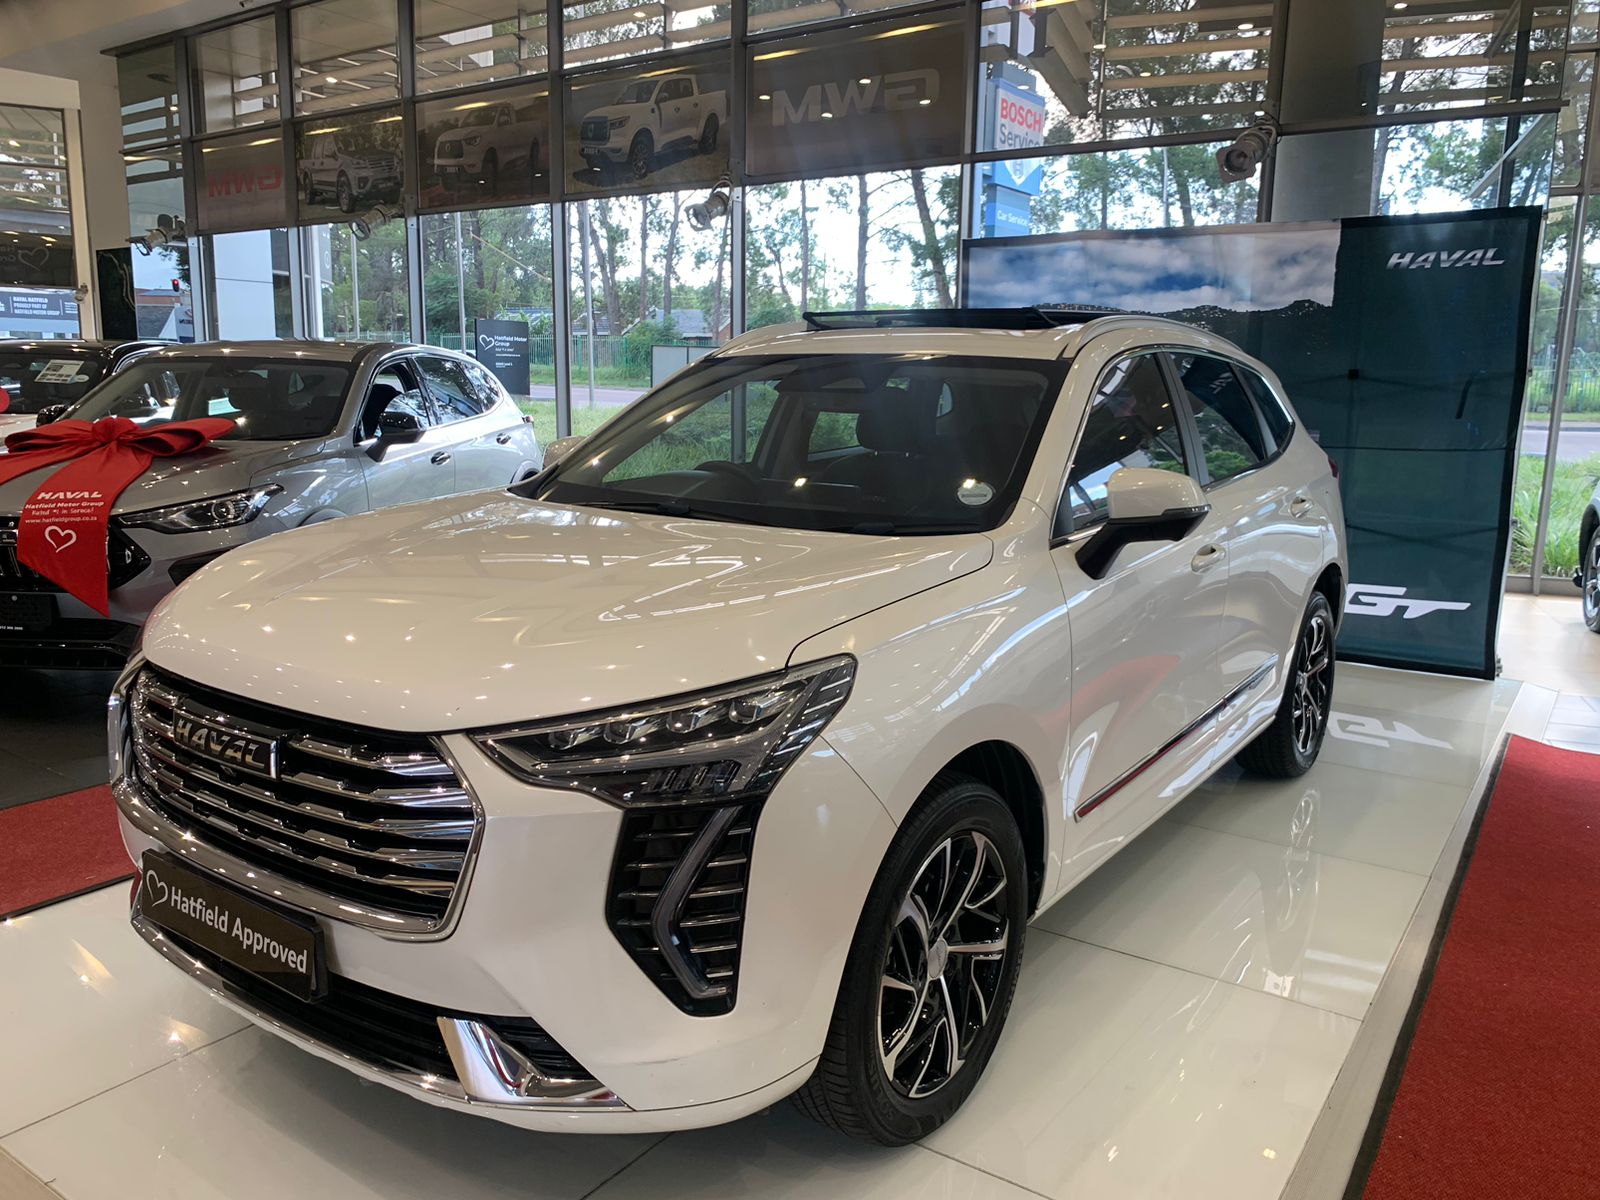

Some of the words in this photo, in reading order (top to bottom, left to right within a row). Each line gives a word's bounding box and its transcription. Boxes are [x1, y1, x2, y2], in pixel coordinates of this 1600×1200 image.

[1000, 97, 1042, 133] BOSCH
[1386, 247, 1504, 269] HAVAL
[37, 491, 102, 500] HAVAL
[175, 718, 264, 769] HAVAL
[171, 886, 229, 933] Hatfield
[232, 917, 308, 974] Approved
